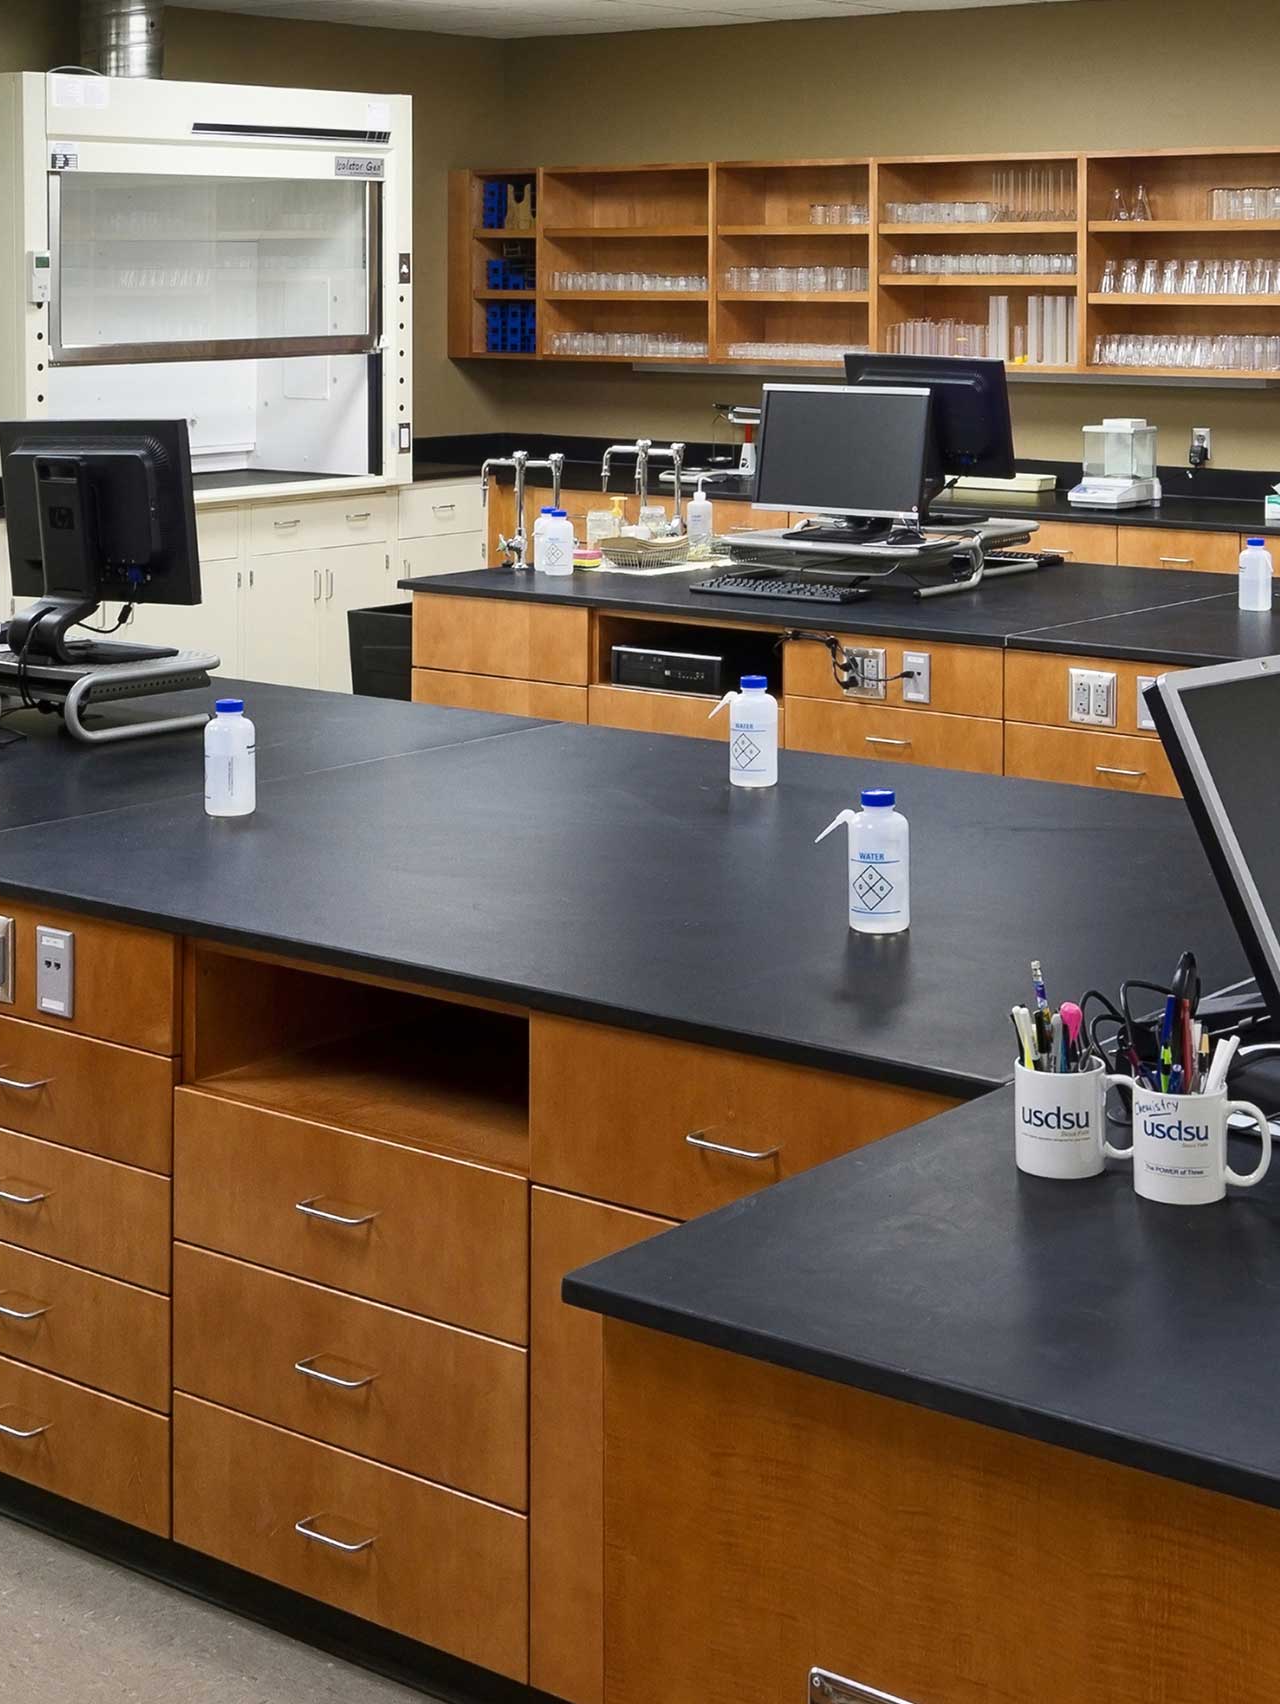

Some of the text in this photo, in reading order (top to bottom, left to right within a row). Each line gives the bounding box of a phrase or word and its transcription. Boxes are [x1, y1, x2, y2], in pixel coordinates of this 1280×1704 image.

[858, 852, 885, 860] WATER
[1022, 1106, 1089, 1130] usdsu
[1144, 1120, 1209, 1142] usdsu
